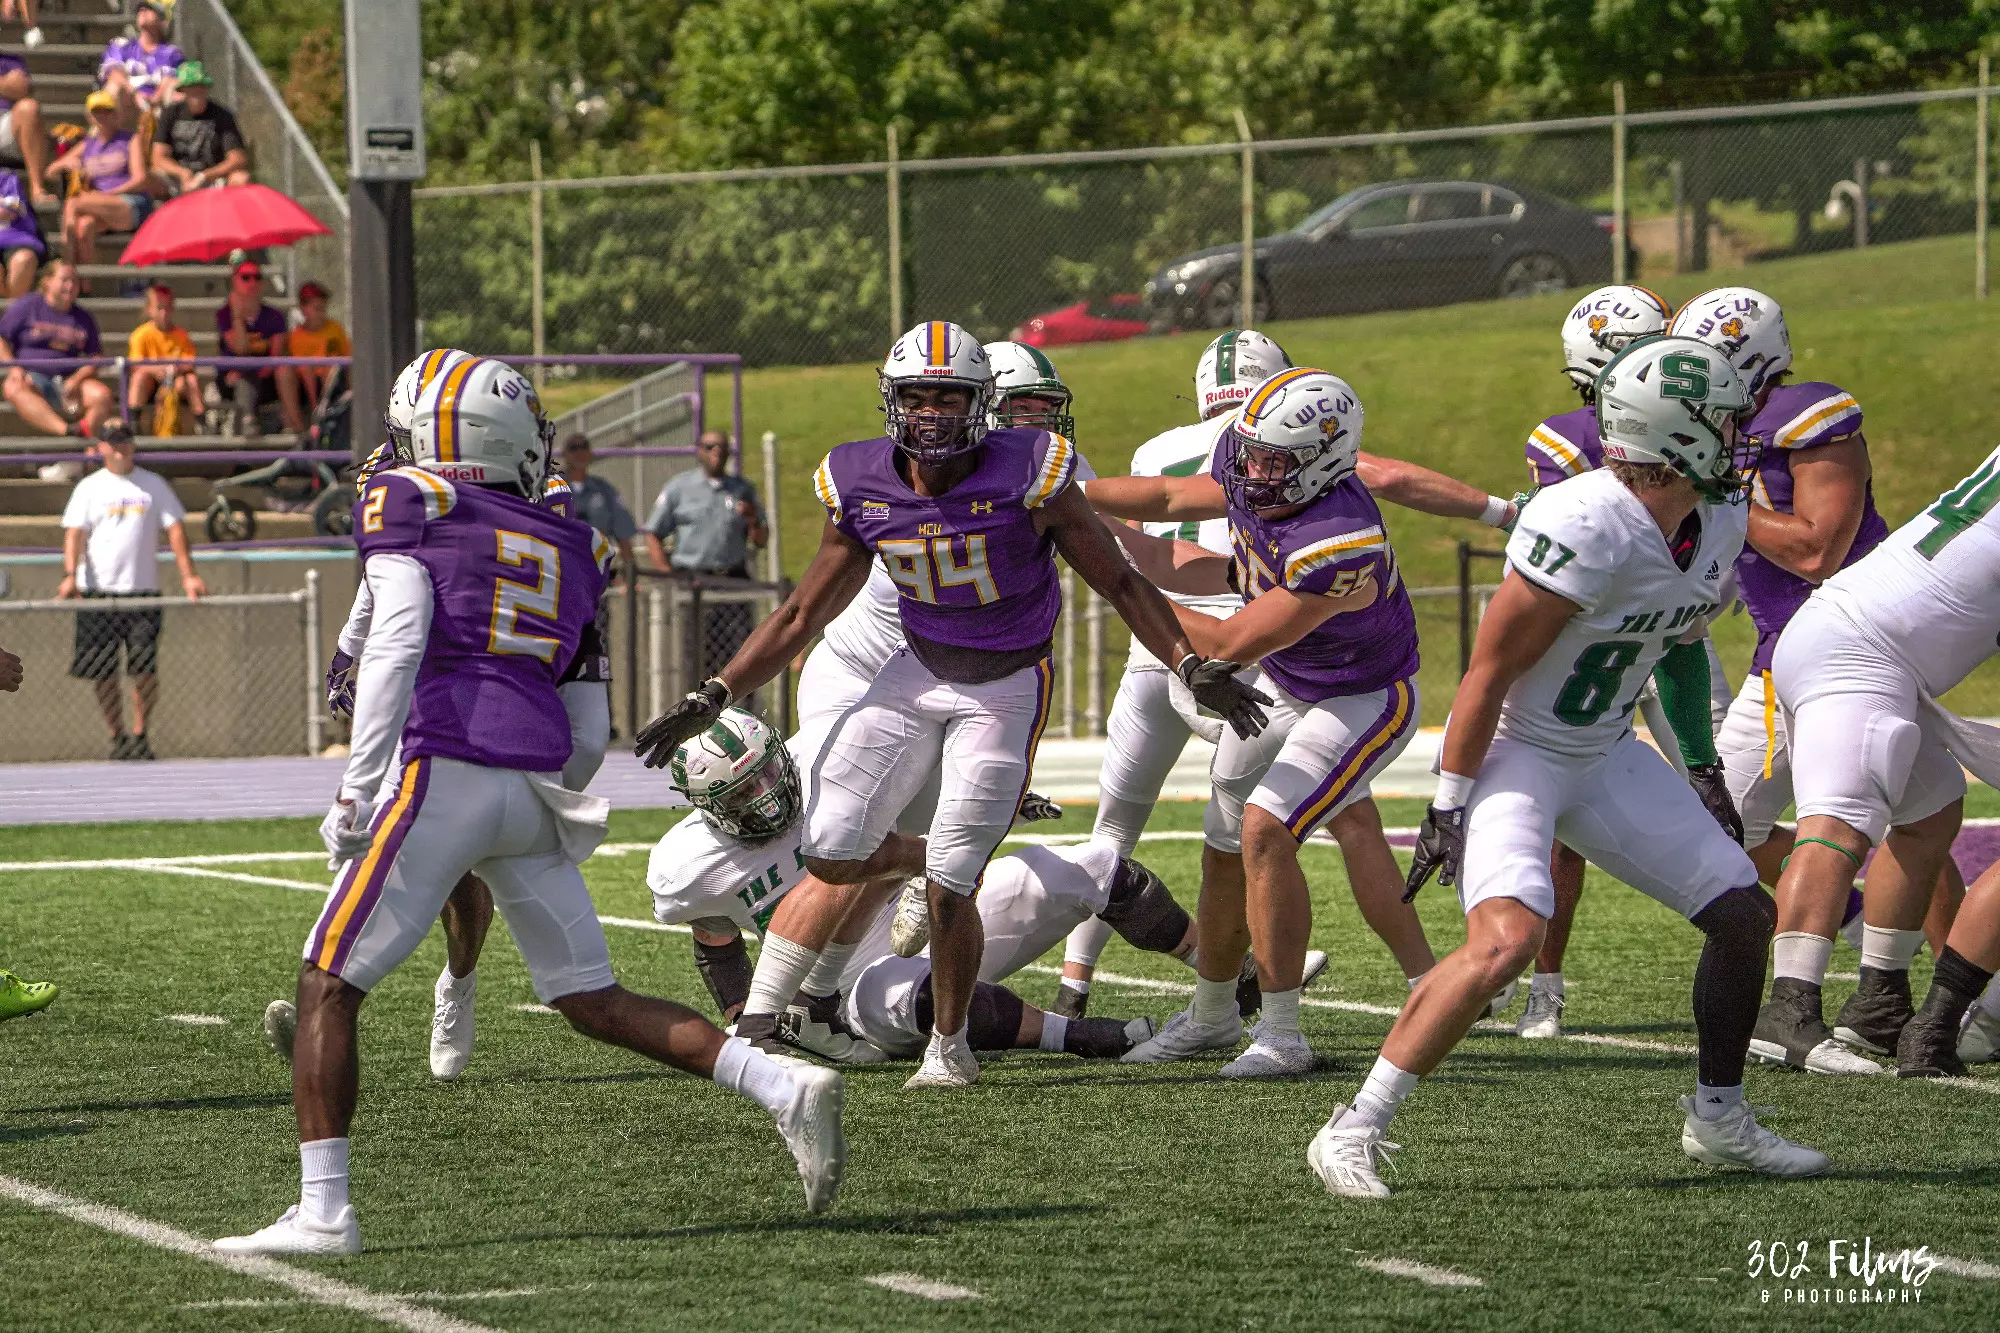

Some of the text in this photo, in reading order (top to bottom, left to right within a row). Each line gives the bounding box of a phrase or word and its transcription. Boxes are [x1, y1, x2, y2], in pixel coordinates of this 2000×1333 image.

[1577, 299, 1631, 320] WCU
[1696, 298, 1751, 337] WCU
[502, 376, 532, 400] WC
[1660, 353, 1709, 401] S
[1295, 397, 1348, 425] WCU
[437, 466, 485, 480] ddell
[363, 486, 388, 534] 2
[918, 523, 942, 535] WCU
[877, 535, 1001, 605] 94
[1323, 561, 1377, 598] 55
[487, 529, 561, 663] 2
[1614, 610, 1665, 633] THE
[1553, 640, 1664, 726] 8
[735, 862, 784, 908] THE
